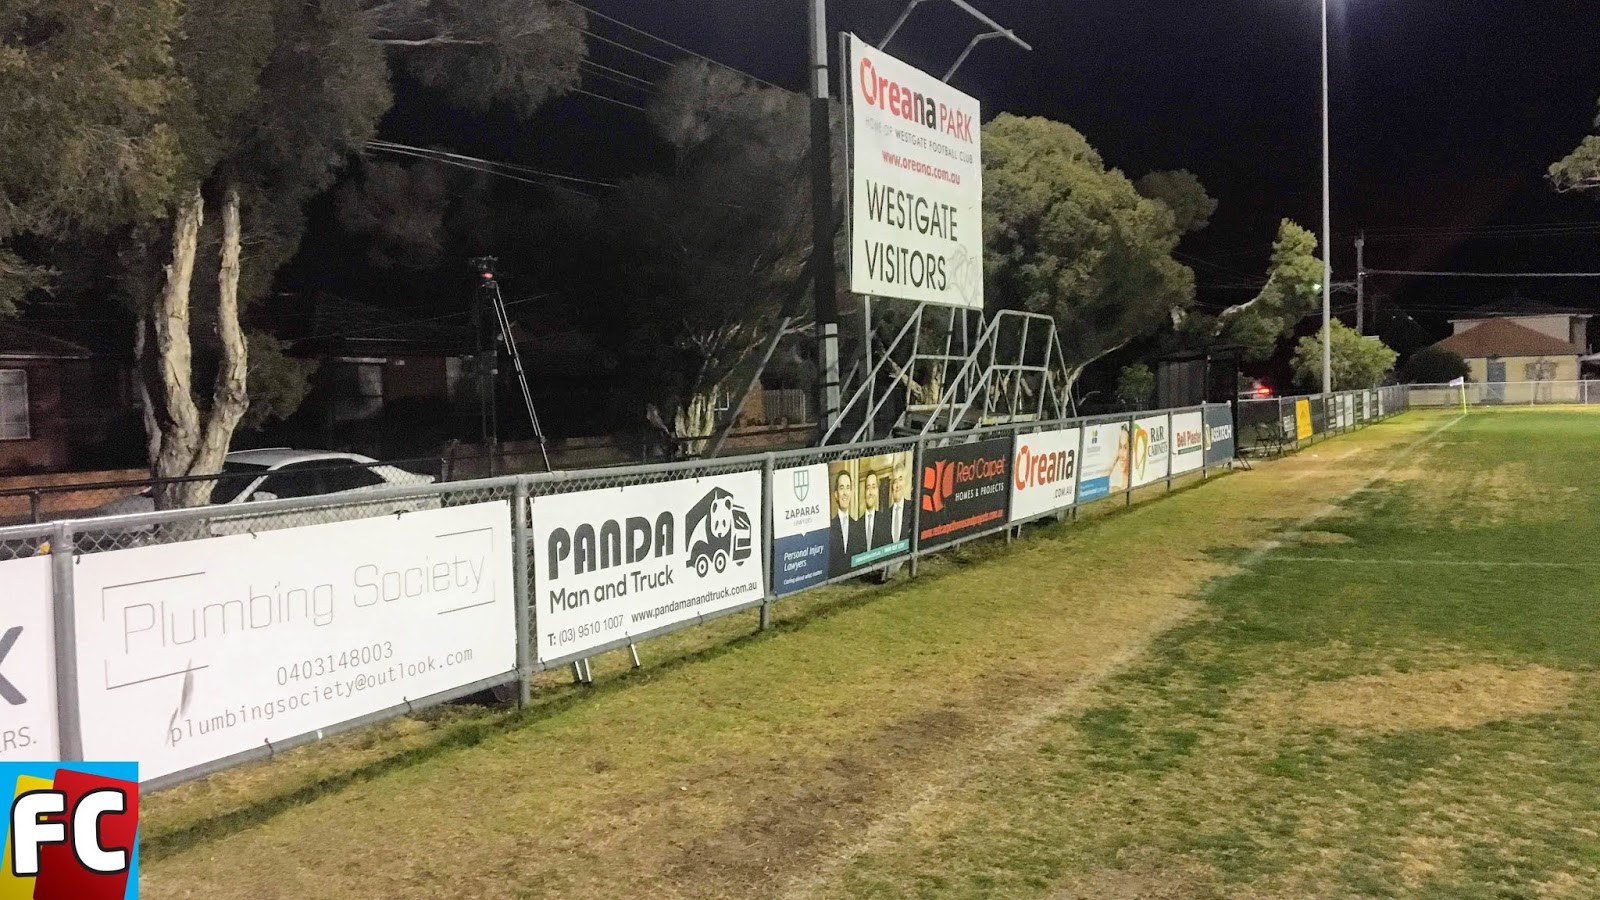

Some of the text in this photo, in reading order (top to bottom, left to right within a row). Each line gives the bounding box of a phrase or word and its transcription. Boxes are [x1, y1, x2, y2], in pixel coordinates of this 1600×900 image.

[860, 57, 973, 144] Oreana PARK
[882, 149, 961, 186] www.oreana.com.au
[895, 128, 928, 149] WESTGATE
[929, 140, 957, 159] FOOTBALL
[960, 150, 973, 164] CLUB
[866, 178, 958, 242] WESTGATE
[864, 239, 947, 291] VISITORS
[956, 454, 1005, 482] Red Carpet
[1014, 445, 1075, 490] Oreana
[785, 504, 820, 520] ZAPARAS
[955, 482, 1004, 502] HOMES & PROJECTS
[547, 511, 675, 581] PANDA
[783, 544, 825, 561] Personal Injury
[783, 559, 807, 572] Lawyers
[123, 554, 486, 655] Plumbing Society
[549, 564, 674, 614] Man and Truck
[547, 581, 758, 647] T: (03) 9510 1007 www.pandamanandtruck.com.au
[276, 640, 394, 687] 0403148003
[170, 645, 474, 748] plumbingsociety@outlook.com
